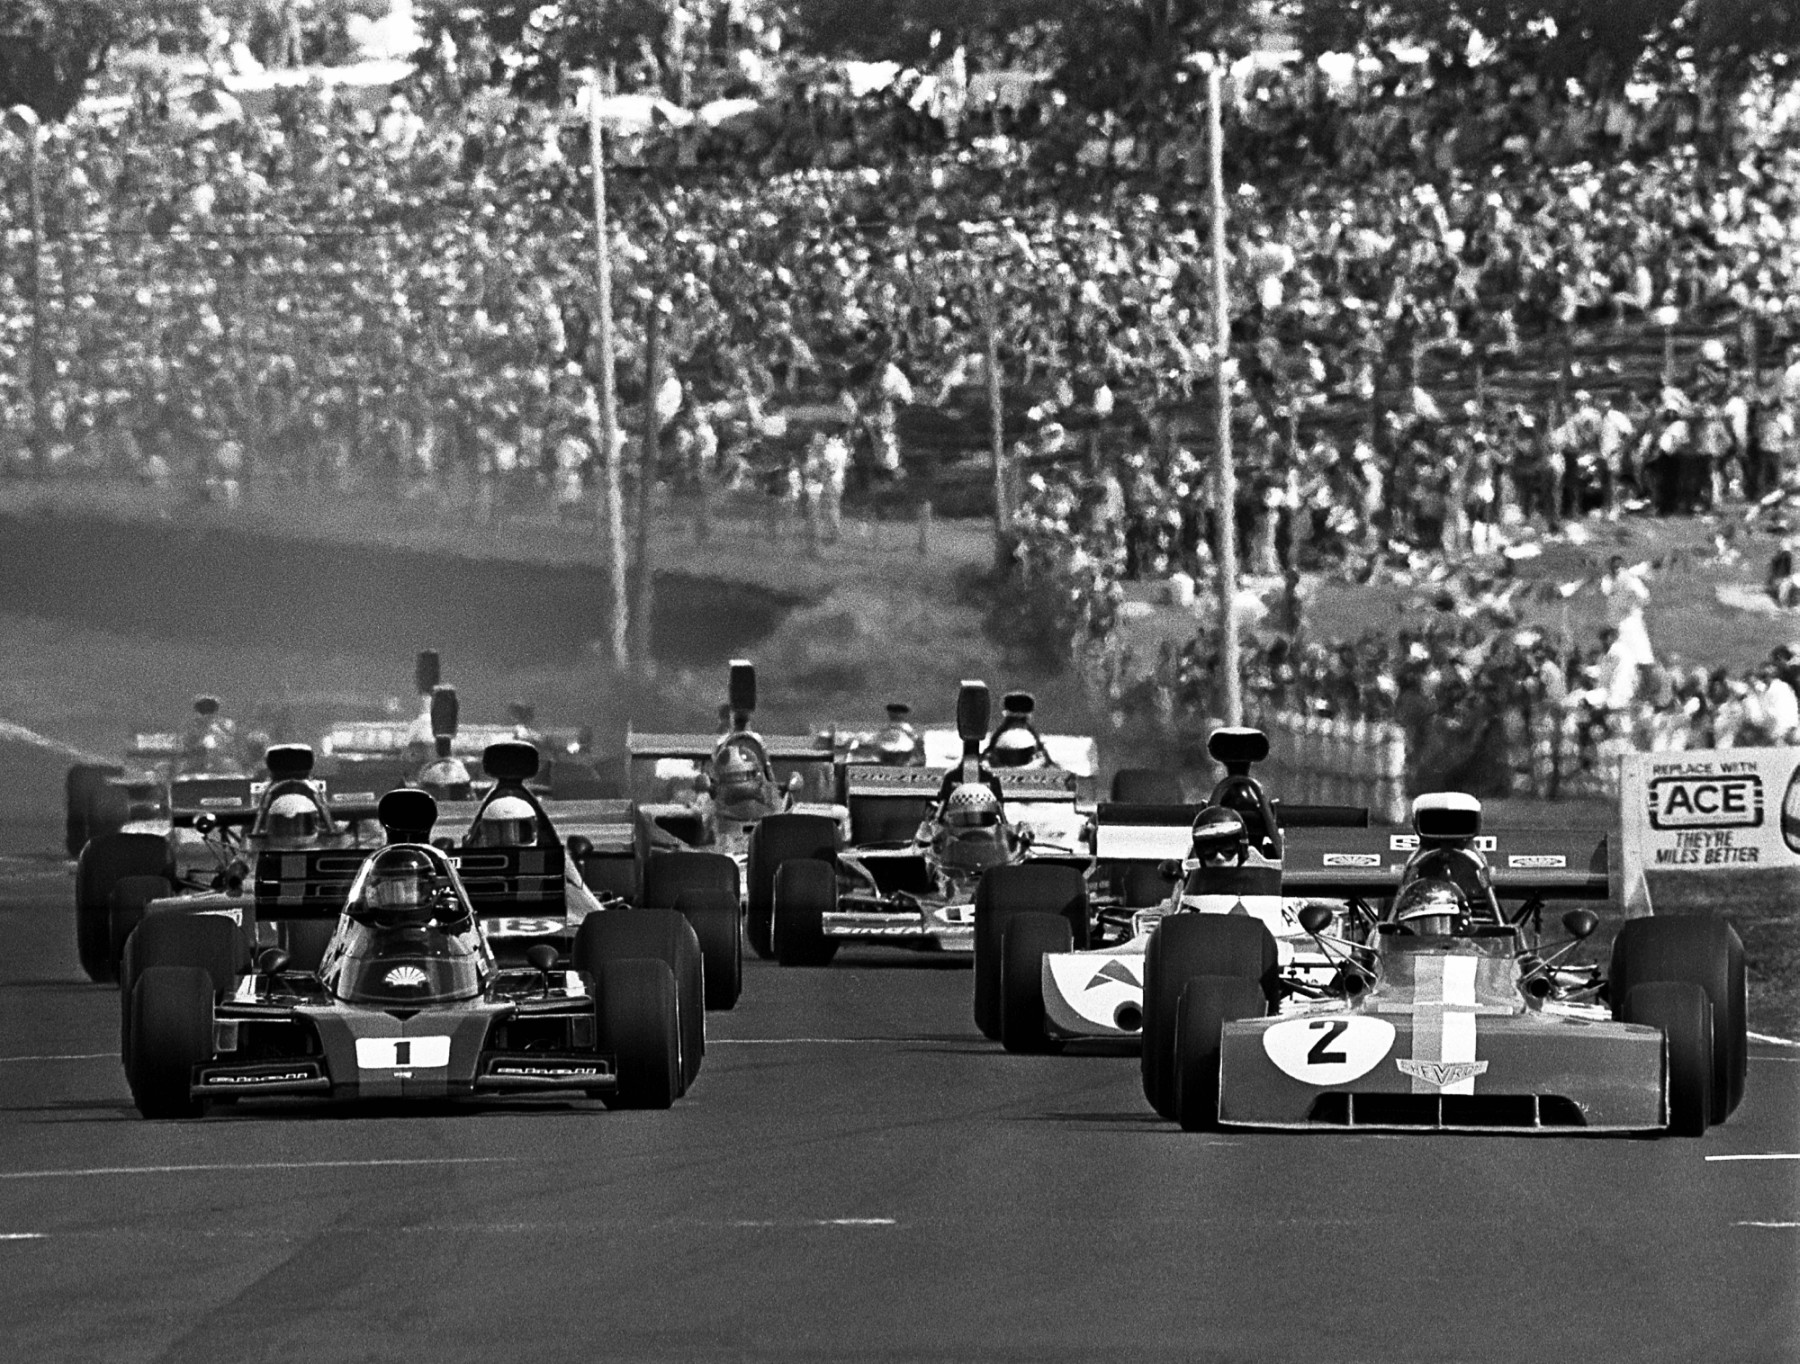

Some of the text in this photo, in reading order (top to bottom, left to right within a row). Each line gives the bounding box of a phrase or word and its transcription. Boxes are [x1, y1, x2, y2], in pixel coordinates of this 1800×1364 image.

[1652, 761, 1757, 775] REPLACE WITH
[1664, 783, 1747, 815] ACE
[1655, 847, 1760, 864] MILES BETTER
[393, 1041, 411, 1065] 1
[1307, 1020, 1349, 1065] 2
